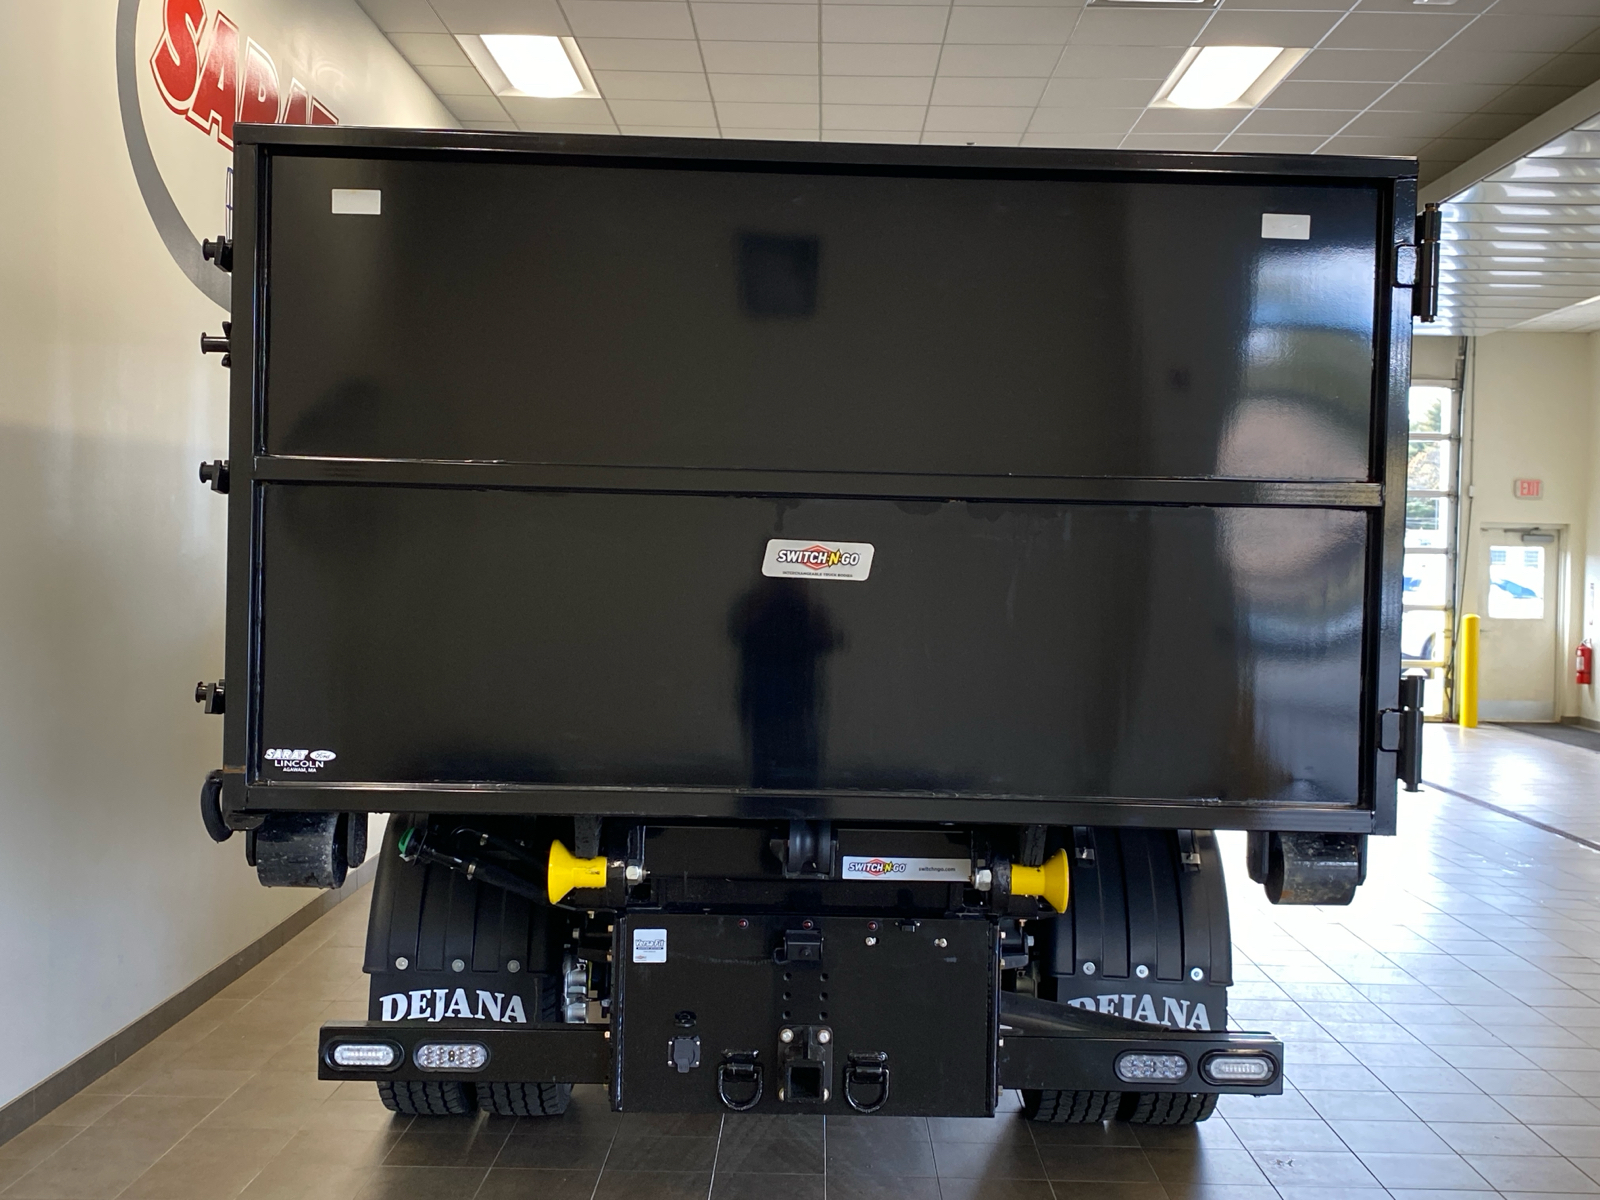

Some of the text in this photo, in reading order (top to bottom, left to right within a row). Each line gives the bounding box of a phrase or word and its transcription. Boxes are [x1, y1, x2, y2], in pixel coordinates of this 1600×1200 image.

[1521, 480, 1540, 496] EXIT
[264, 749, 308, 760] SARAT
[274, 760, 324, 768] LINCOLN
[379, 988, 527, 1023] DEJANA
